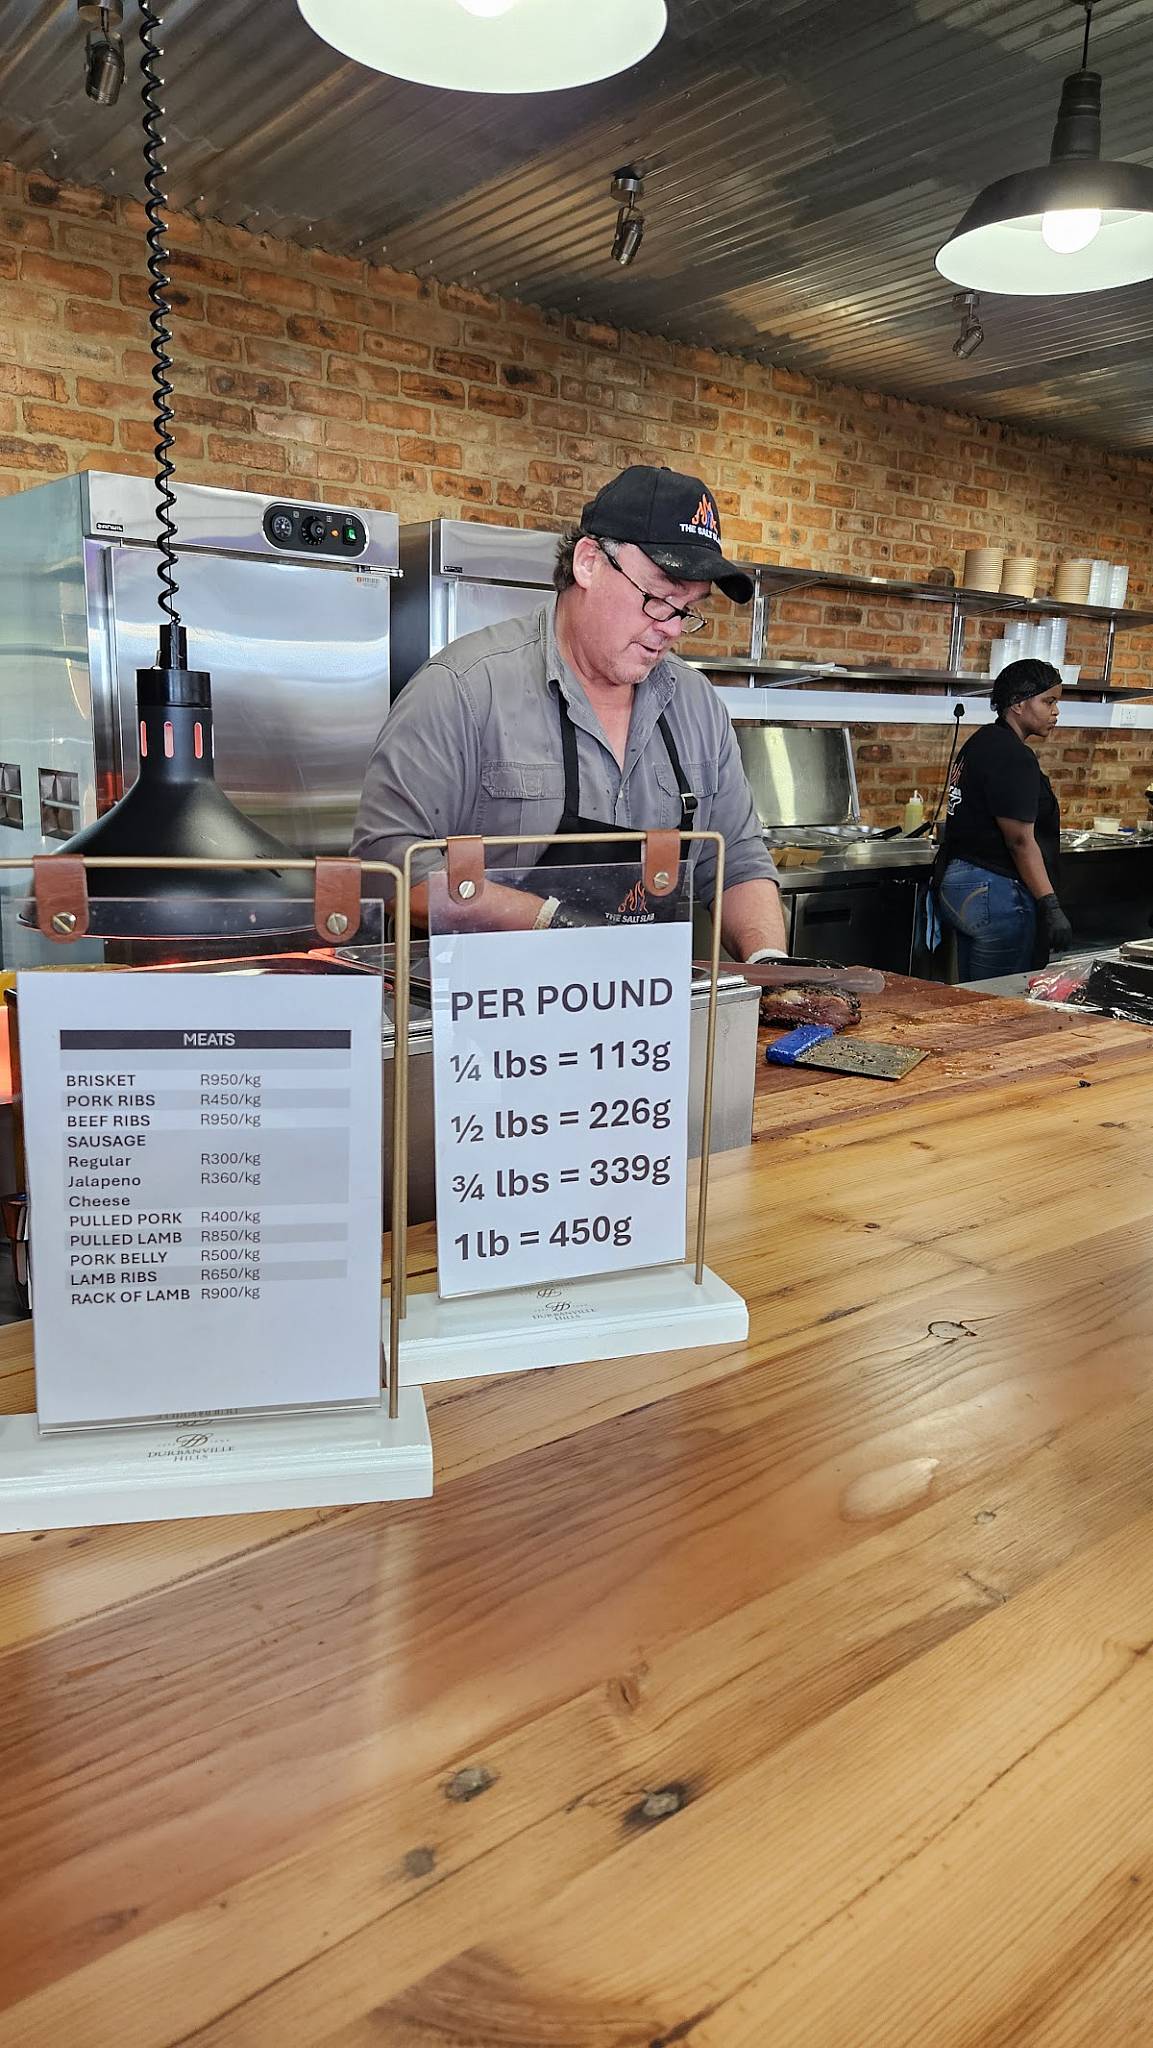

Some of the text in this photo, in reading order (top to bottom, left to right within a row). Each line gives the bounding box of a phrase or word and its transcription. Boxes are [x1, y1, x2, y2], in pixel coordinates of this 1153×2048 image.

[680, 523, 696, 533] THE
[697, 527, 712, 539] SALT
[605, 912, 621, 922] THE
[622, 915, 640, 923] SALT
[452, 978, 672, 1021] PER POUND
[184, 1033, 235, 1046] MEATS
[494, 1050, 547, 1078] lbs
[590, 1040, 670, 1071] 113g
[67, 1074, 261, 1088] BRISKET R950/kg
[67, 1094, 261, 1107] PORK RIBS R450/kg
[68, 1113, 261, 1127] BEEF RIBS R950/kg
[496, 1110, 548, 1138] lbs
[590, 1098, 671, 1129] 226g
[68, 1135, 145, 1147] SAUSAGE
[69, 1152, 260, 1170] Regular R300/kg
[68, 1172, 260, 1189] Jalapeno R360/kg
[497, 1169, 549, 1197] lbs
[590, 1155, 670, 1186] 339g
[69, 1196, 130, 1207] Cheese
[70, 1211, 260, 1227] PULLED PORK R400/kg
[71, 1230, 260, 1246] PULLED LAMB R850/kg
[550, 1216, 631, 1247] 450g
[71, 1248, 260, 1266] PORK BELLY R500/kg
[71, 1267, 260, 1285] LAMB RIBS R650/kg
[72, 1286, 260, 1304] RACK OF LAMB R900/kg
